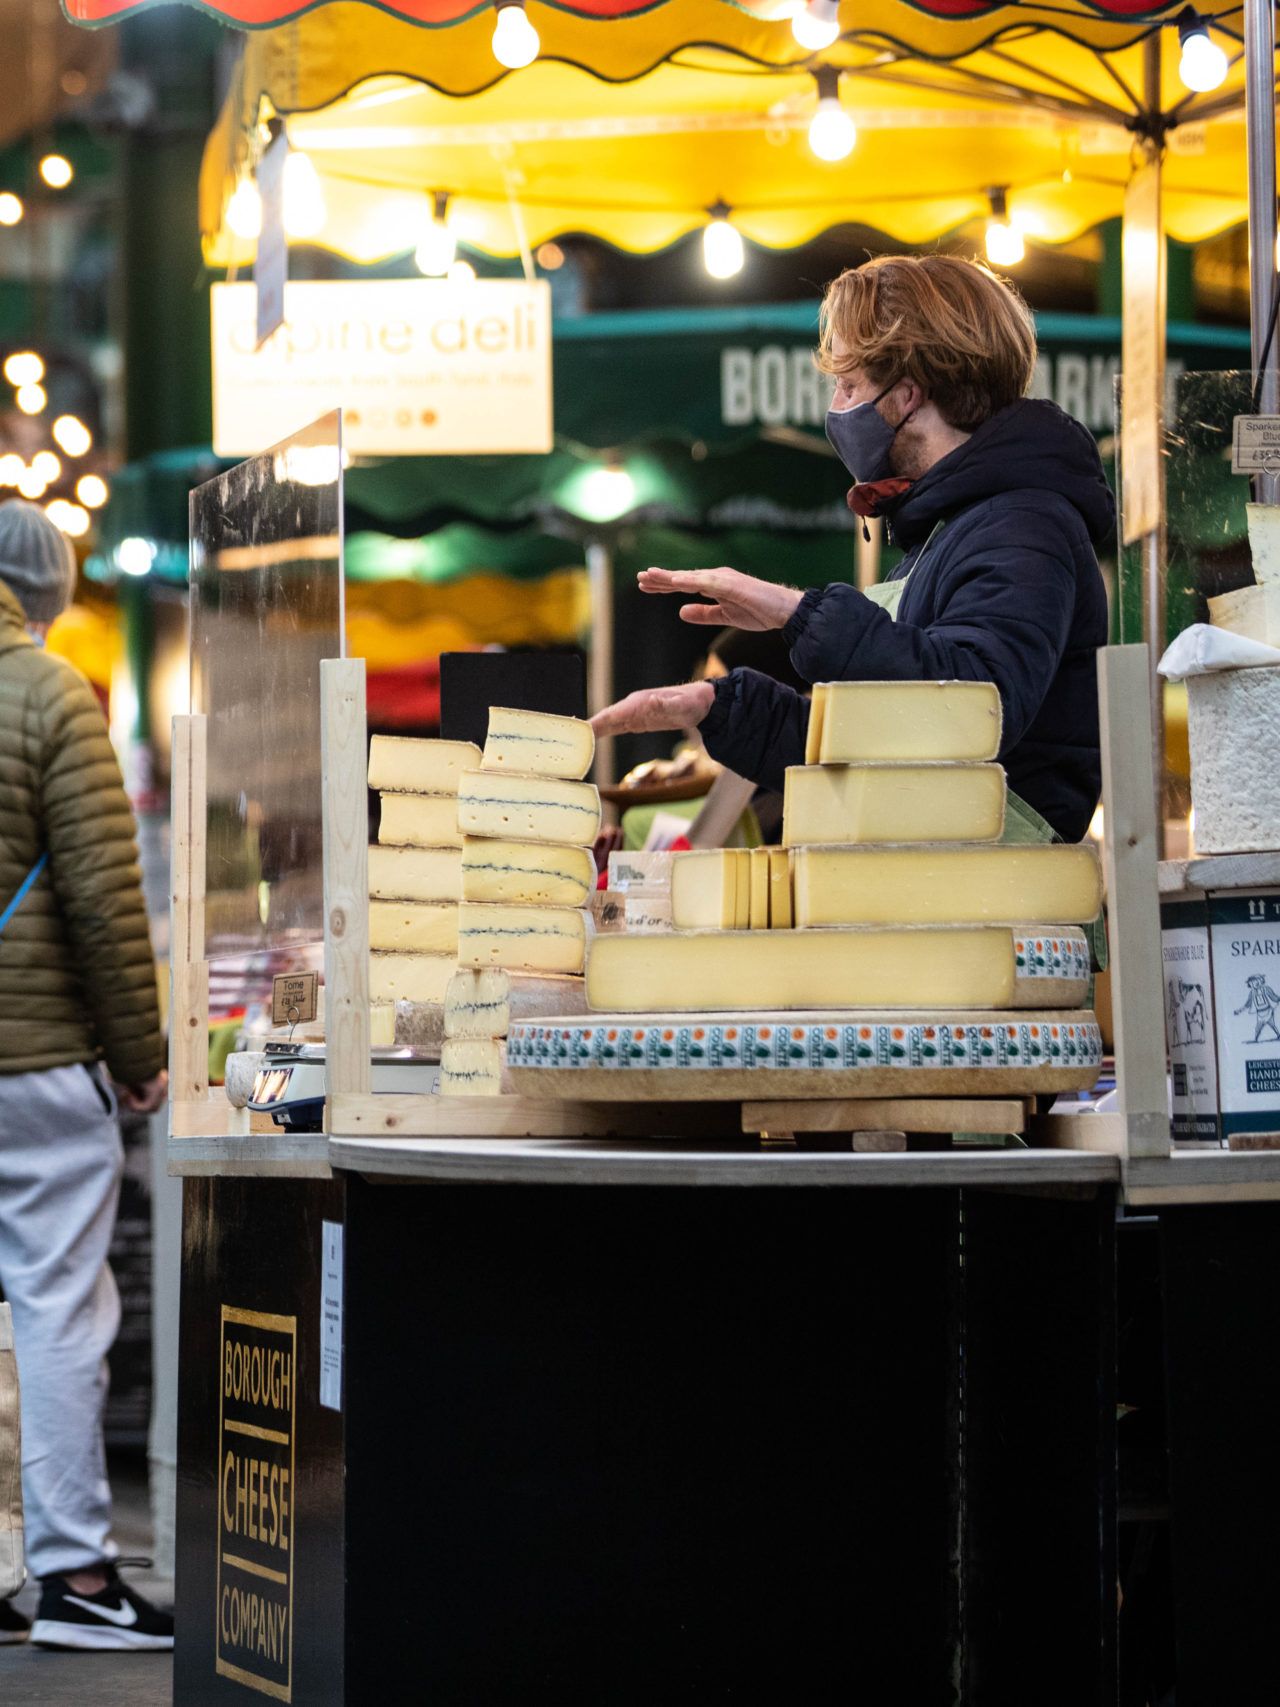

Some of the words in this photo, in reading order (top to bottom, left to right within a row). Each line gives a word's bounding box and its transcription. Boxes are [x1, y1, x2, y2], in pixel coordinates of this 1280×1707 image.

[429, 302, 535, 354] deli
[283, 980, 304, 991] Tome
[225, 1339, 291, 1412] BOROUGH
[223, 1450, 289, 1550] CHEESE
[221, 1584, 287, 1665] COMPANY
